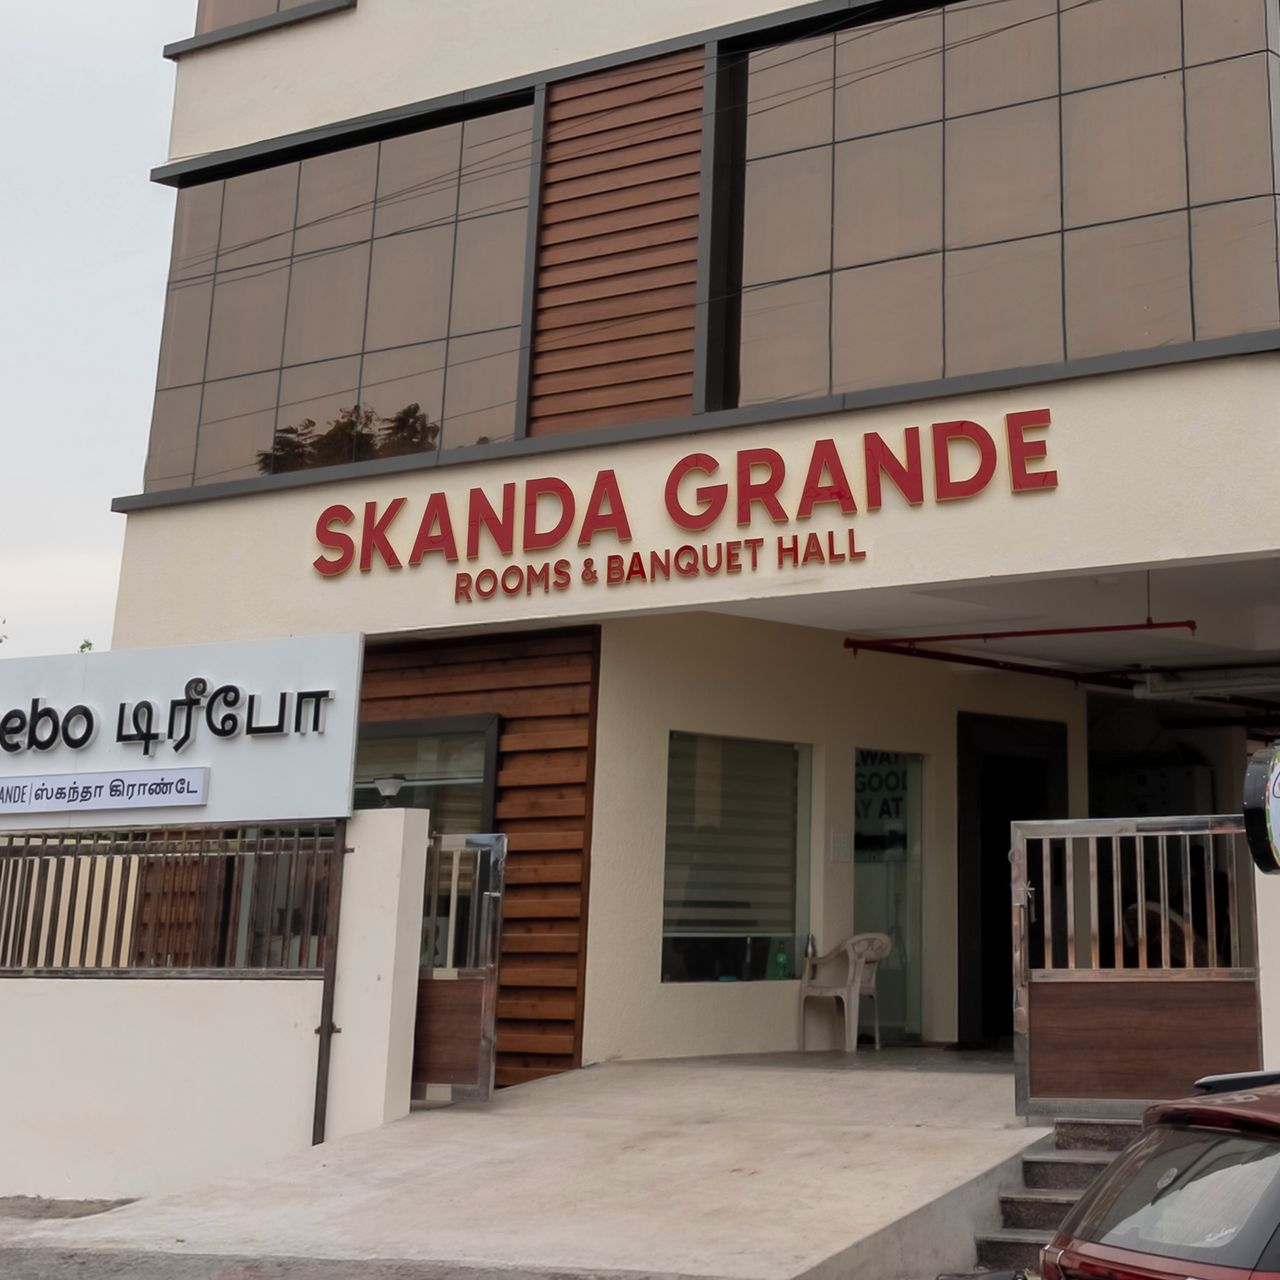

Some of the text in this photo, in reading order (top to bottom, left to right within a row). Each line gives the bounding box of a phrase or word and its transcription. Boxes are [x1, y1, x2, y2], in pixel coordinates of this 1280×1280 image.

[312, 407, 1059, 577] SKANDA GRANDE
[454, 528, 867, 604] ROOMS & BANQUET HALL
[116, 677, 336, 757] டிரீபோ
[34, 777, 198, 803] ஸ்கந்தா கிராண்டே
